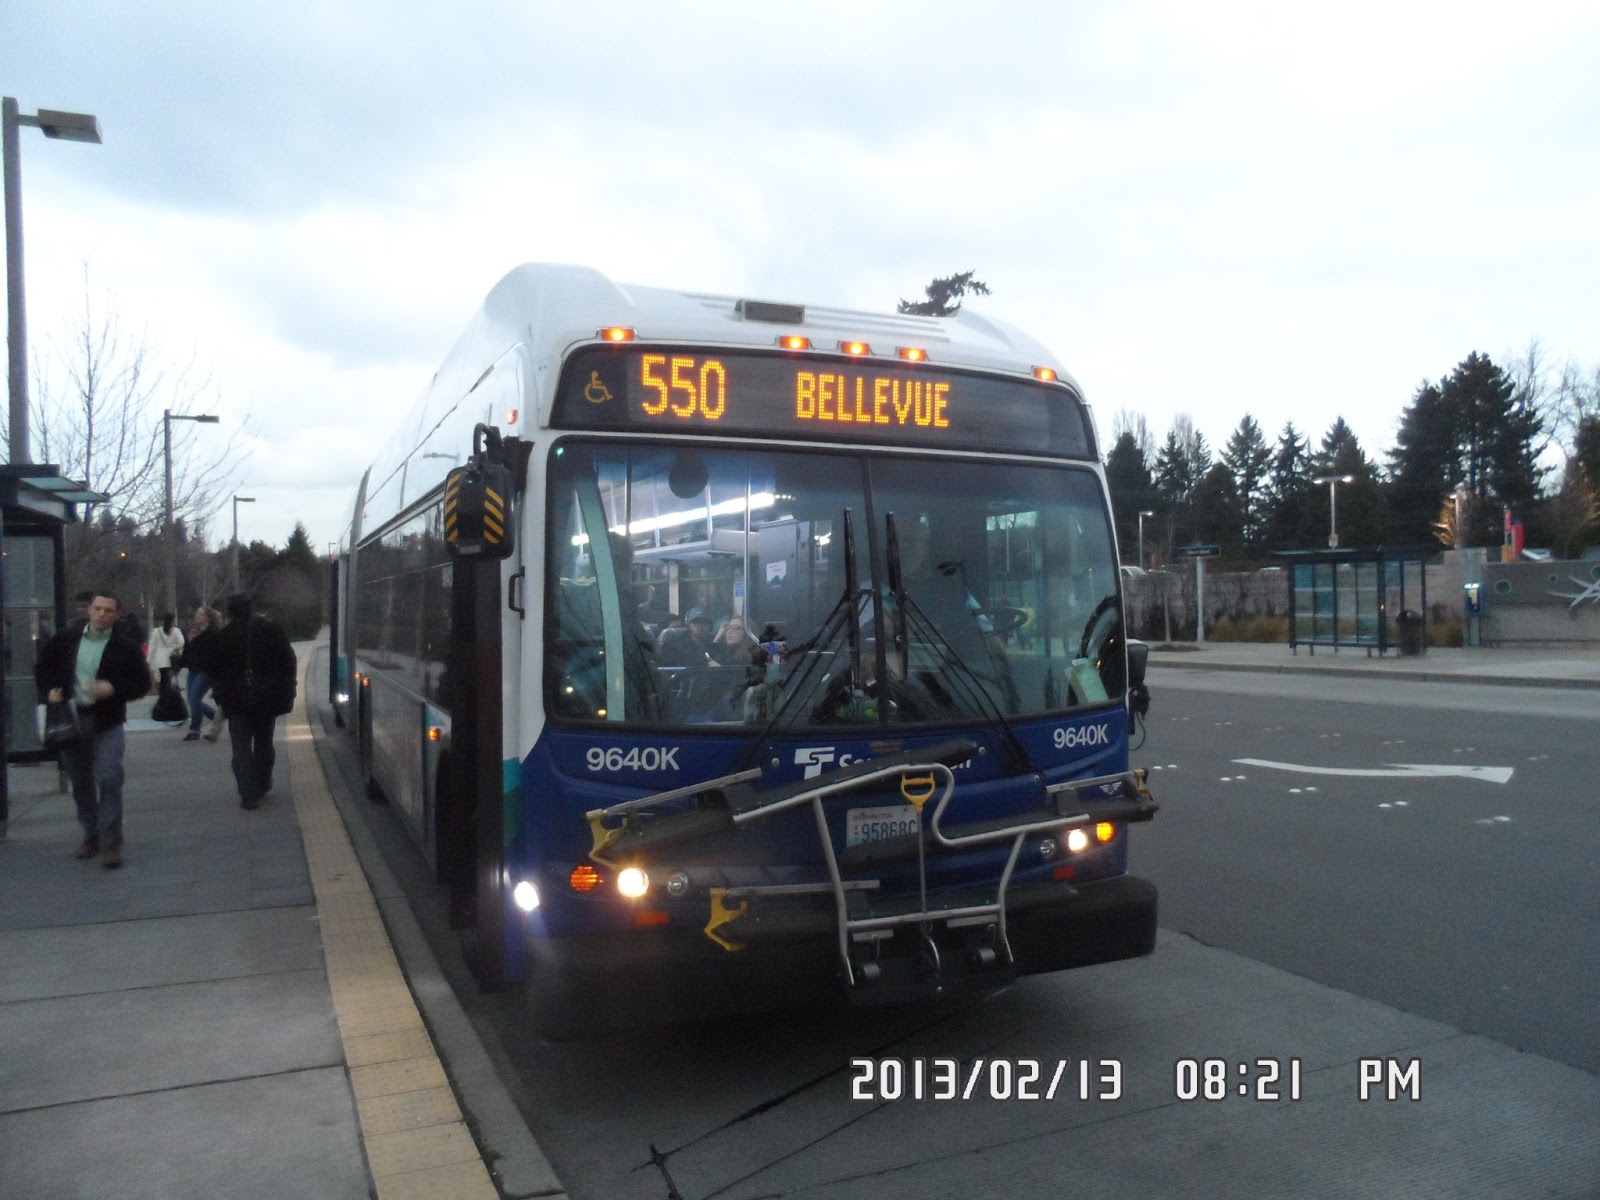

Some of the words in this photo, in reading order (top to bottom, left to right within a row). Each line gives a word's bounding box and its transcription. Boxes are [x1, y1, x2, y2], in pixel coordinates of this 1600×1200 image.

[641, 354, 726, 420] 550
[796, 371, 950, 428] BELLEVUE
[1053, 723, 1109, 749] 9640K
[586, 747, 680, 771] 9640K
